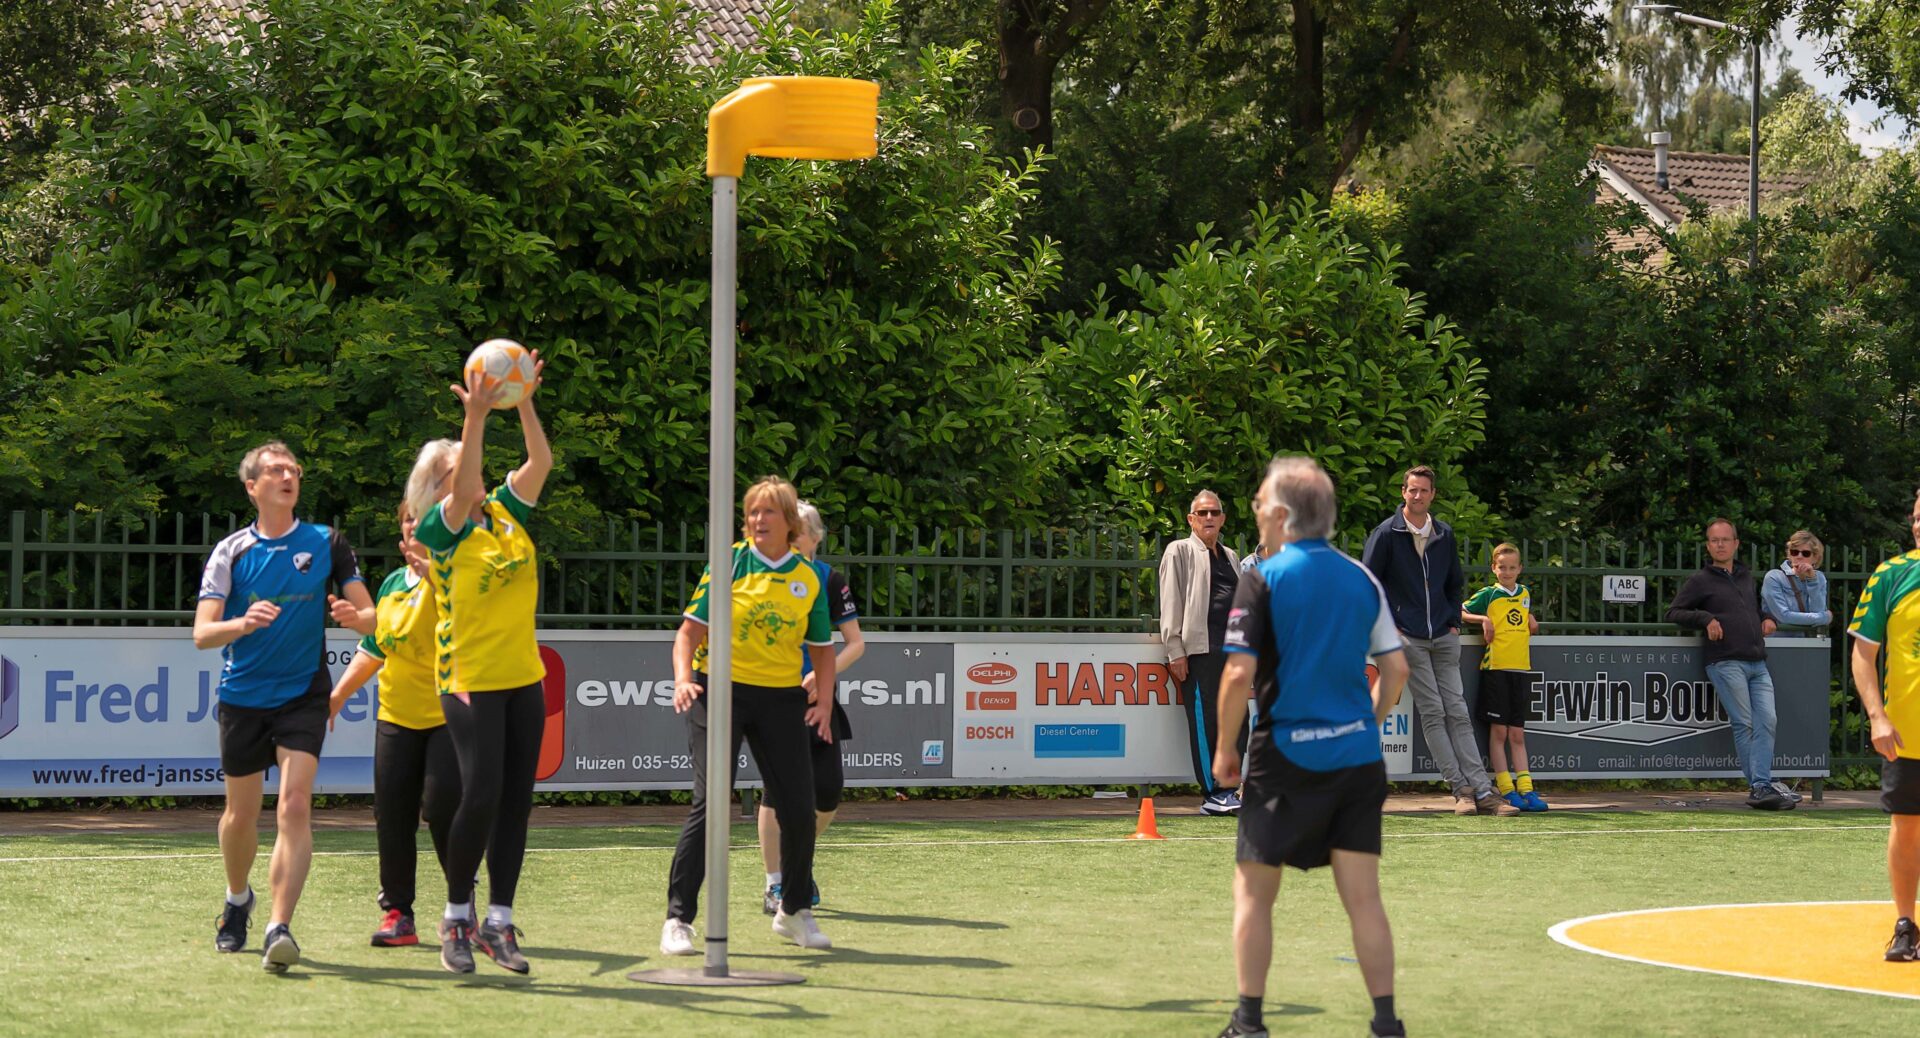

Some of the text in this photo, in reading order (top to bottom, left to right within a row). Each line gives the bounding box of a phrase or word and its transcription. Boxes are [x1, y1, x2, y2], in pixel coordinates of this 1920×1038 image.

[1618, 579, 1639, 589] ABC
[1562, 653, 1692, 664] TEGELWERKEN
[972, 669, 1011, 677] DELPHI
[45, 666, 169, 723] Fred
[983, 697, 1010, 705] DENSO
[1524, 671, 1632, 723] Erwin
[966, 726, 1015, 740] BOSCH
[1039, 726, 1099, 736] Diesel Center
[1380, 741, 1408, 753] lmere
[575, 756, 626, 770] Huizen
[842, 752, 903, 767] HILDERS
[1530, 756, 1545, 769] 23
[1549, 755, 1566, 769] 45
[1567, 755, 1582, 768] 61
[1598, 755, 1636, 769] email:
